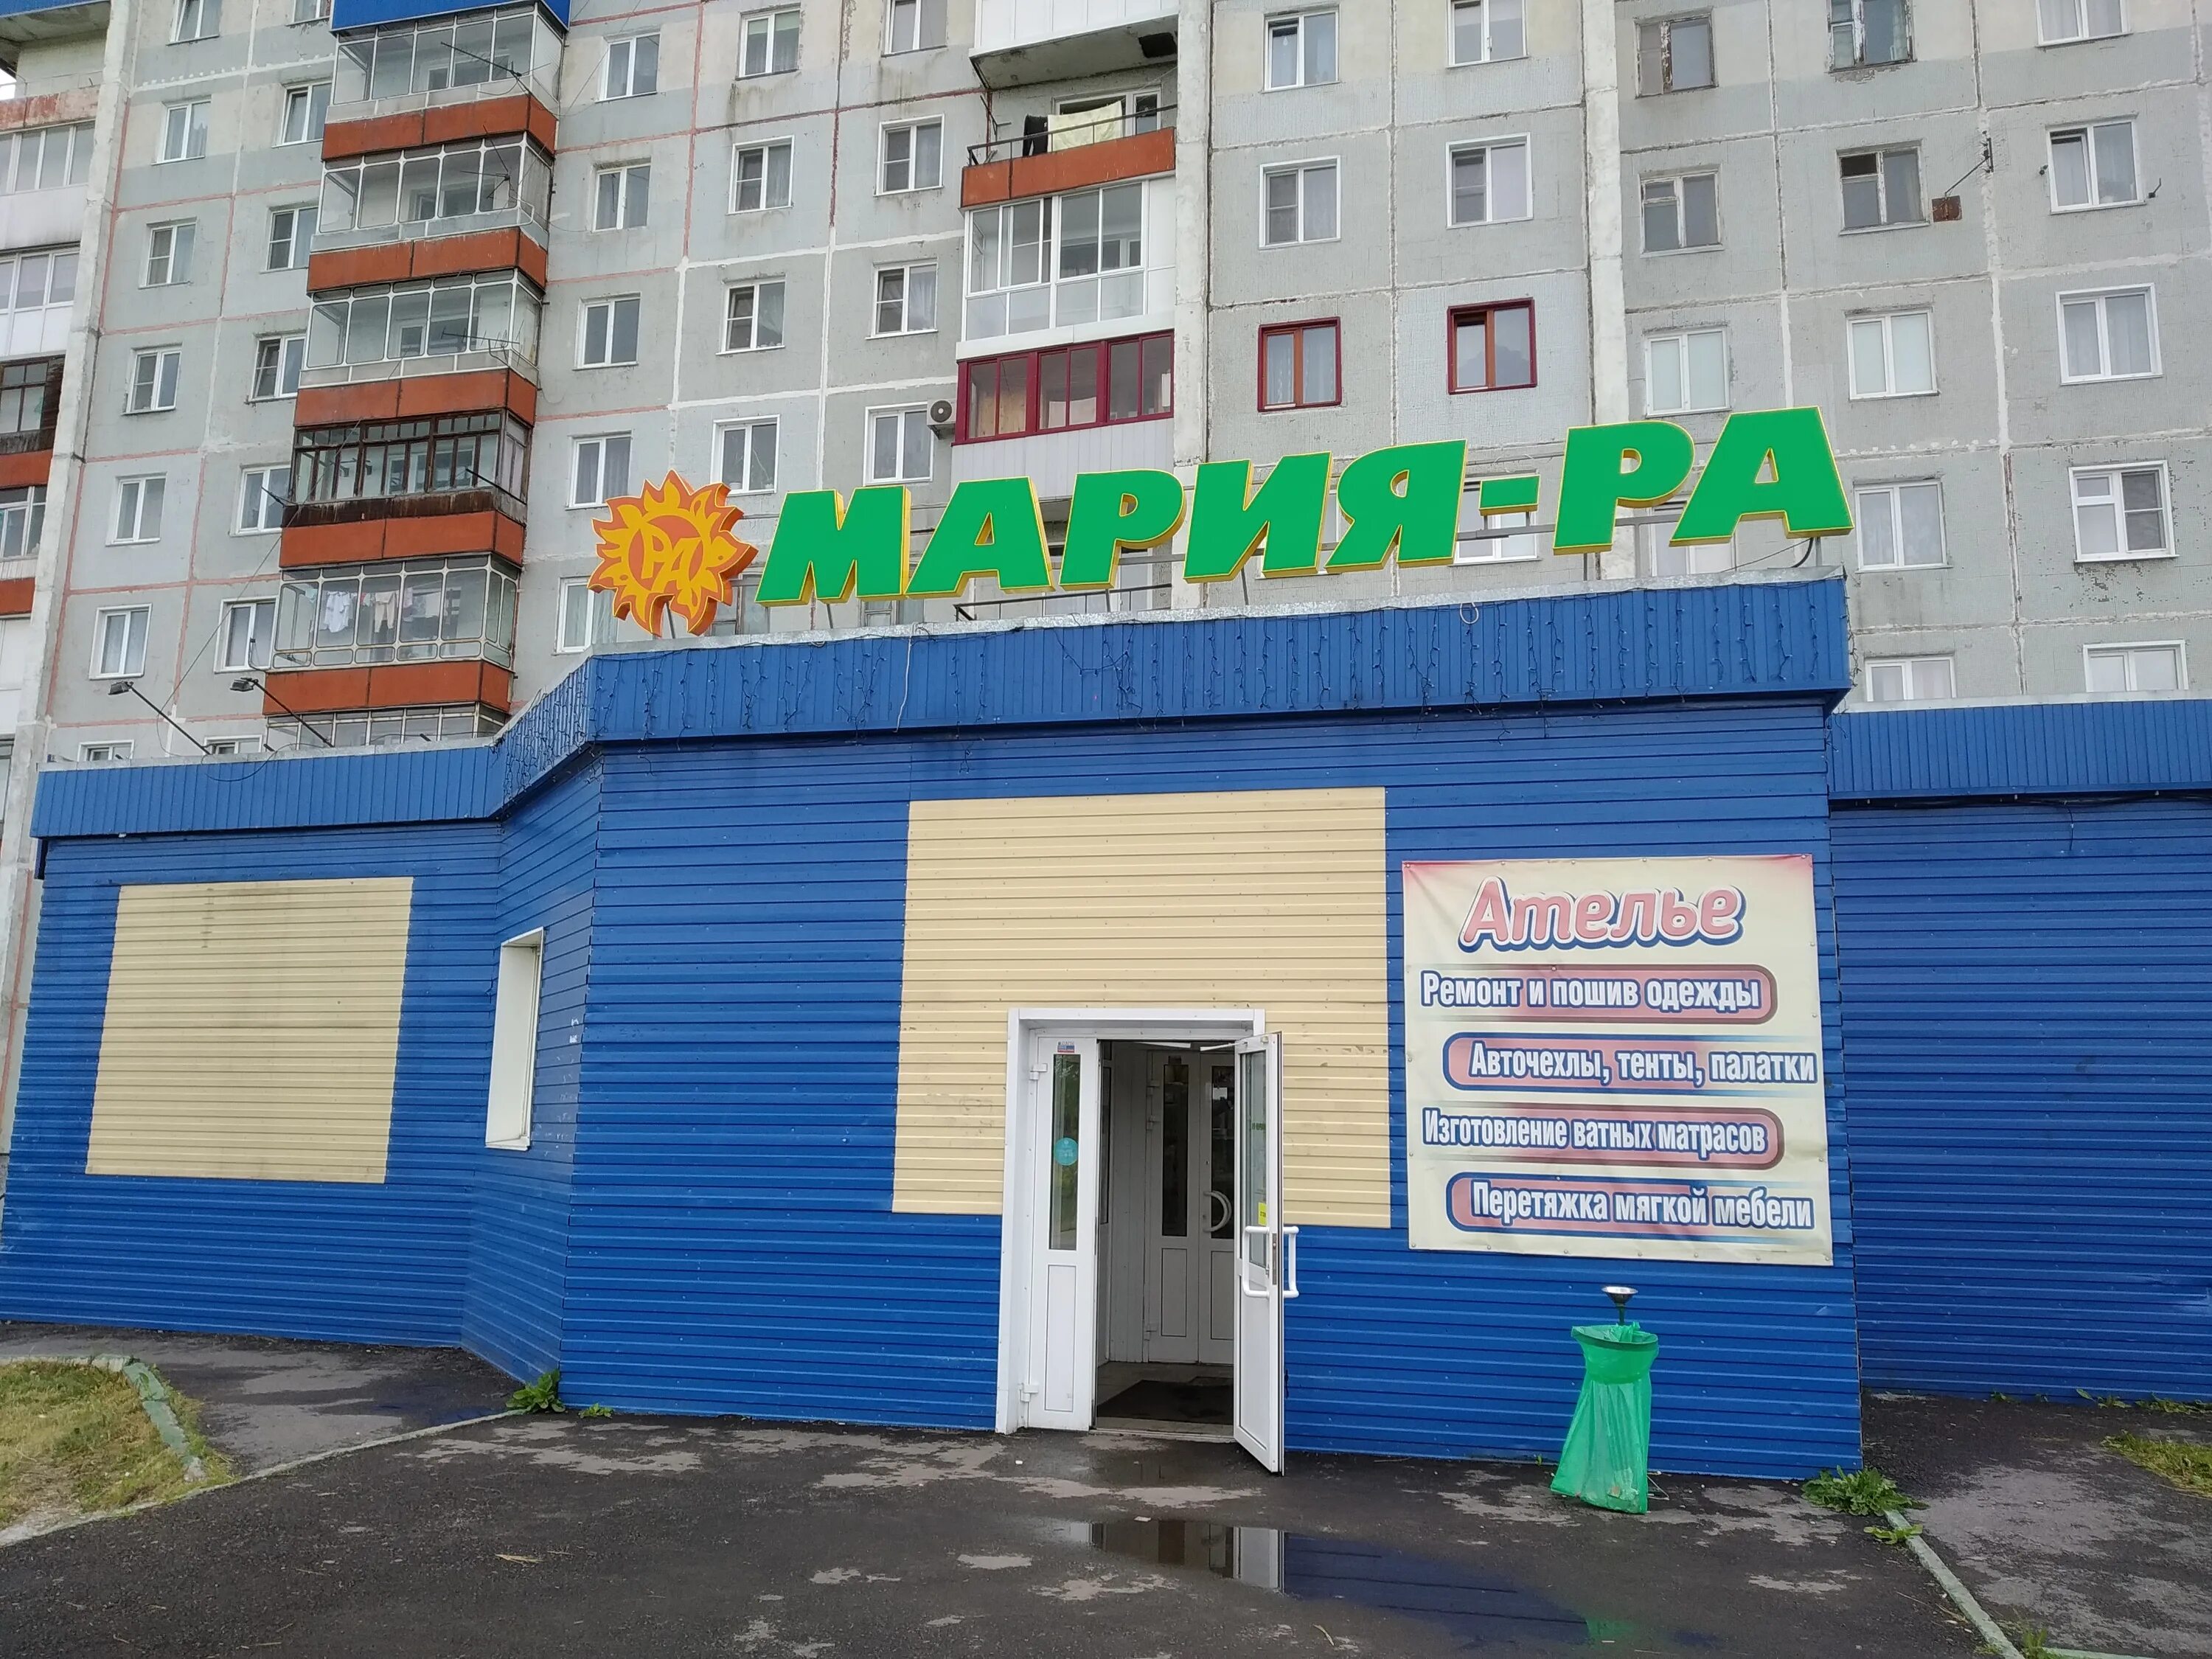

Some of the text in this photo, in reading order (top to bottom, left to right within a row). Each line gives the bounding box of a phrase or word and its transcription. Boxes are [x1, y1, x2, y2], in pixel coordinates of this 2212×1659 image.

[755, 406, 1854, 607] МАРИЯ-РА
[1458, 876, 1745, 951] Ателье
[1422, 971, 1761, 1013] Ремонт и пошив одежды
[1469, 1041, 1817, 1087] Авточехлы, тенты, палатки
[1423, 1109, 1767, 1160] Изготовление ватных матрасов
[1472, 1180, 1816, 1229] Перетяжка мягкой мебели
